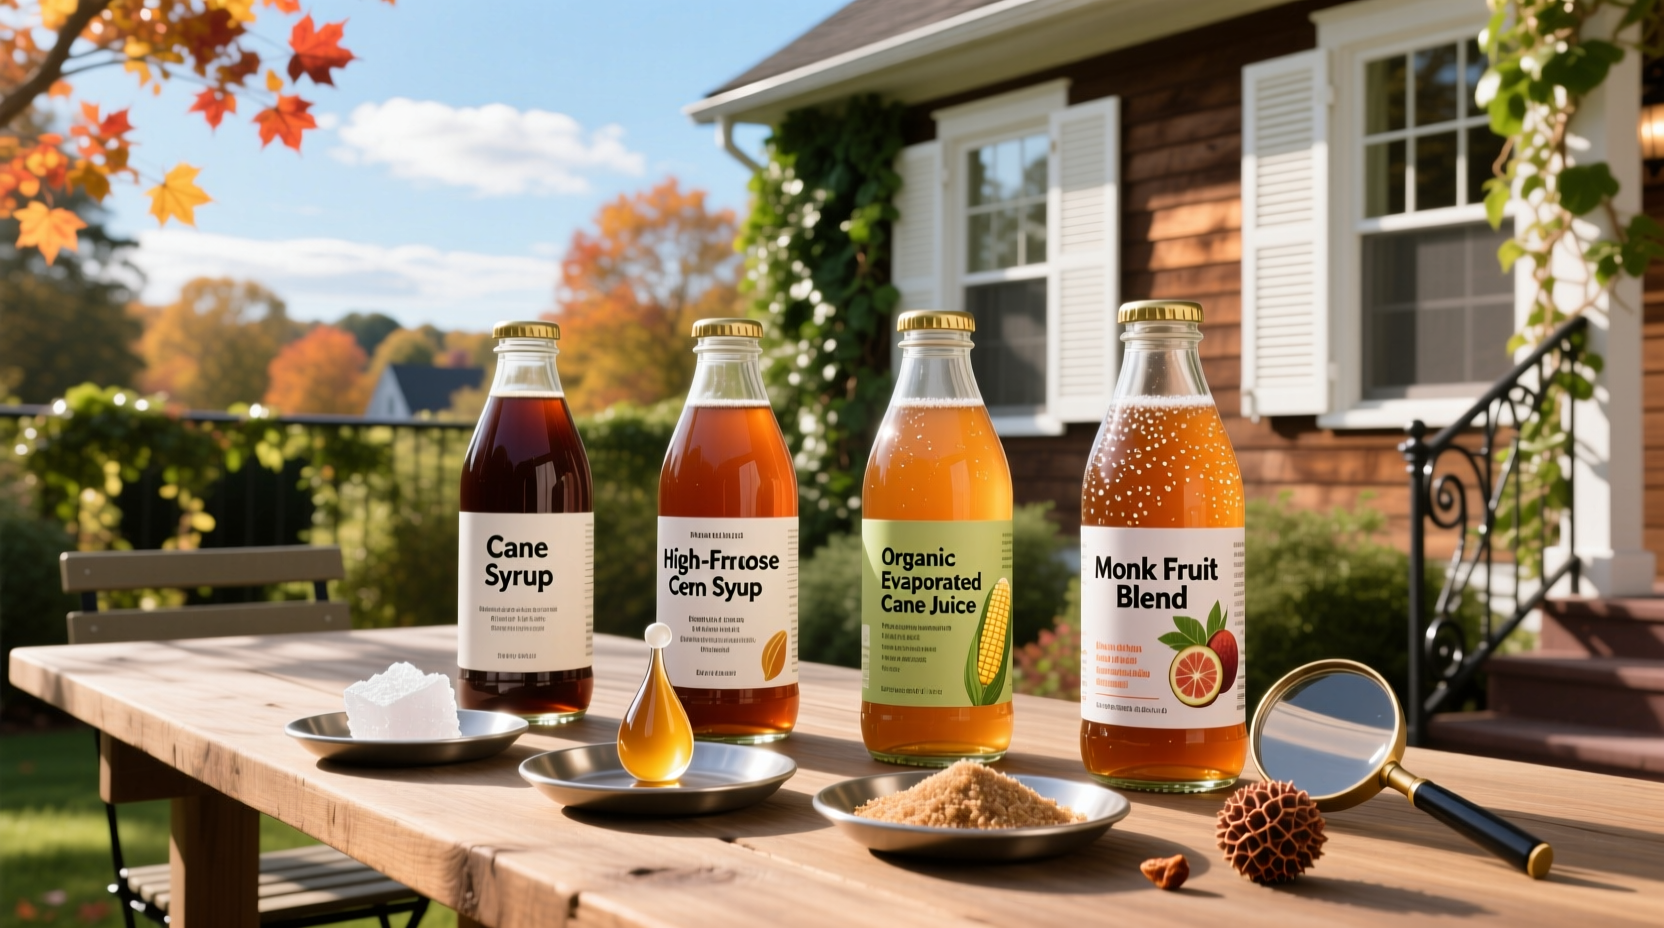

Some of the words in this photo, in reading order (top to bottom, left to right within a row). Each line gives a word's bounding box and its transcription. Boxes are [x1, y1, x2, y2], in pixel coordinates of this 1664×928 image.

[486, 534, 549, 559] Cane
[881, 546, 956, 571] Organic
[484, 563, 554, 593] Syrup
[1095, 555, 1158, 581] Monk
[1163, 556, 1219, 581] Fruit
[712, 576, 763, 603] Syup
[881, 570, 982, 595] Evaporated
[881, 594, 927, 614] Cane
[929, 595, 977, 616] Juice
[1116, 584, 1188, 609] Blend
